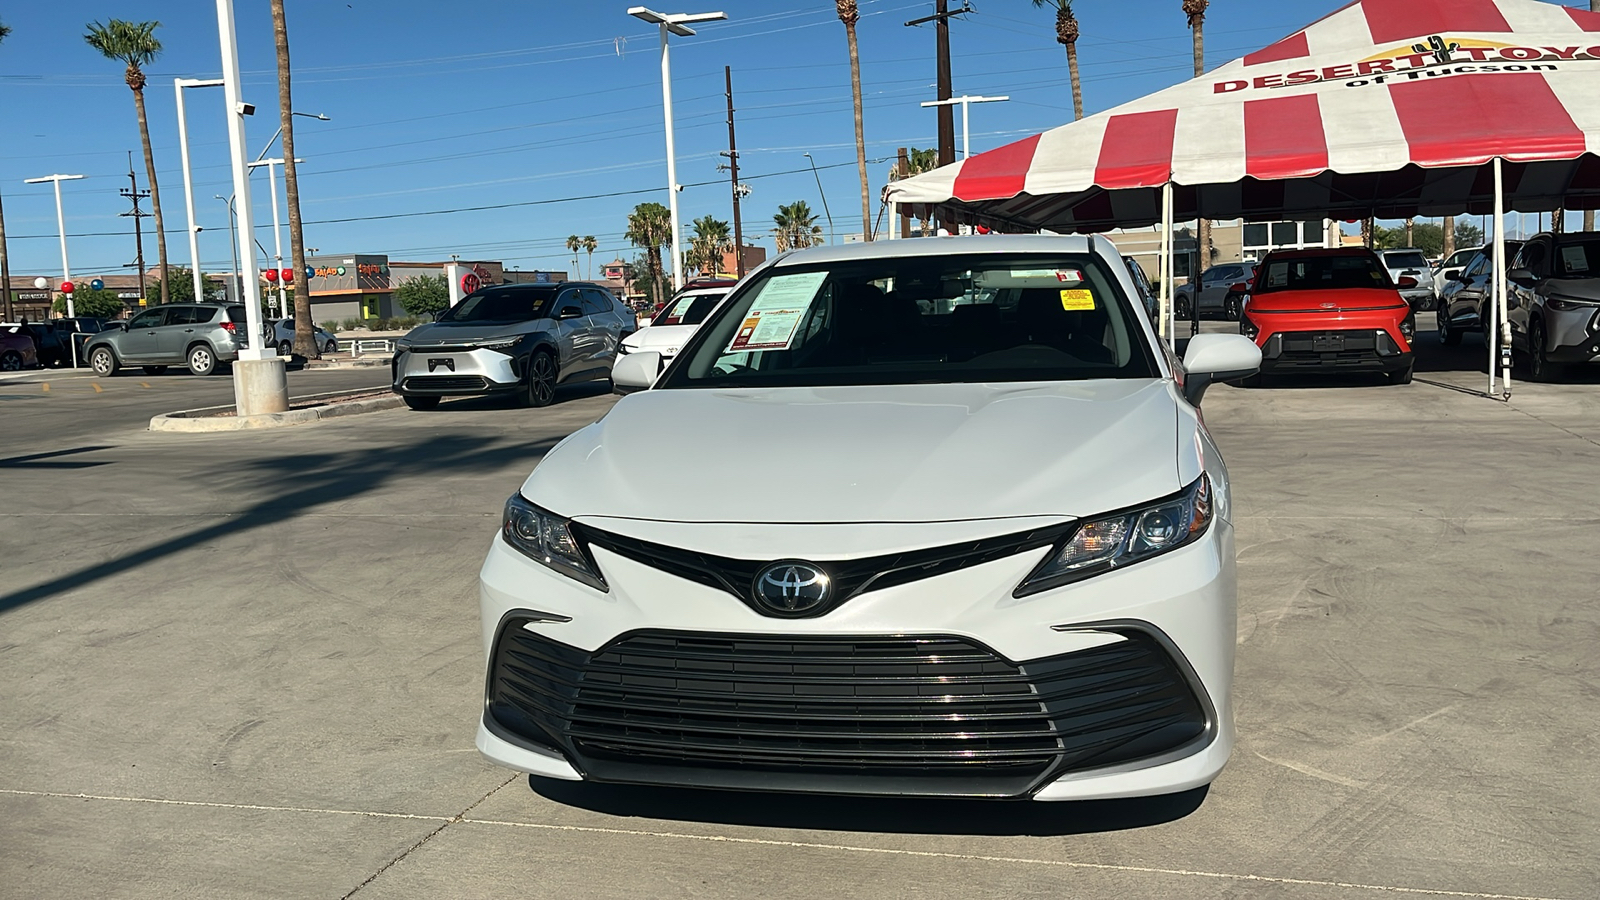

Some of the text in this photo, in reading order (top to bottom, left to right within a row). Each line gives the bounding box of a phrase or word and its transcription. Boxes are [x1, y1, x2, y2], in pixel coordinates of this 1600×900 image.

[1213, 52, 1433, 94] DESERT
[1345, 64, 1559, 88] of Tucson
